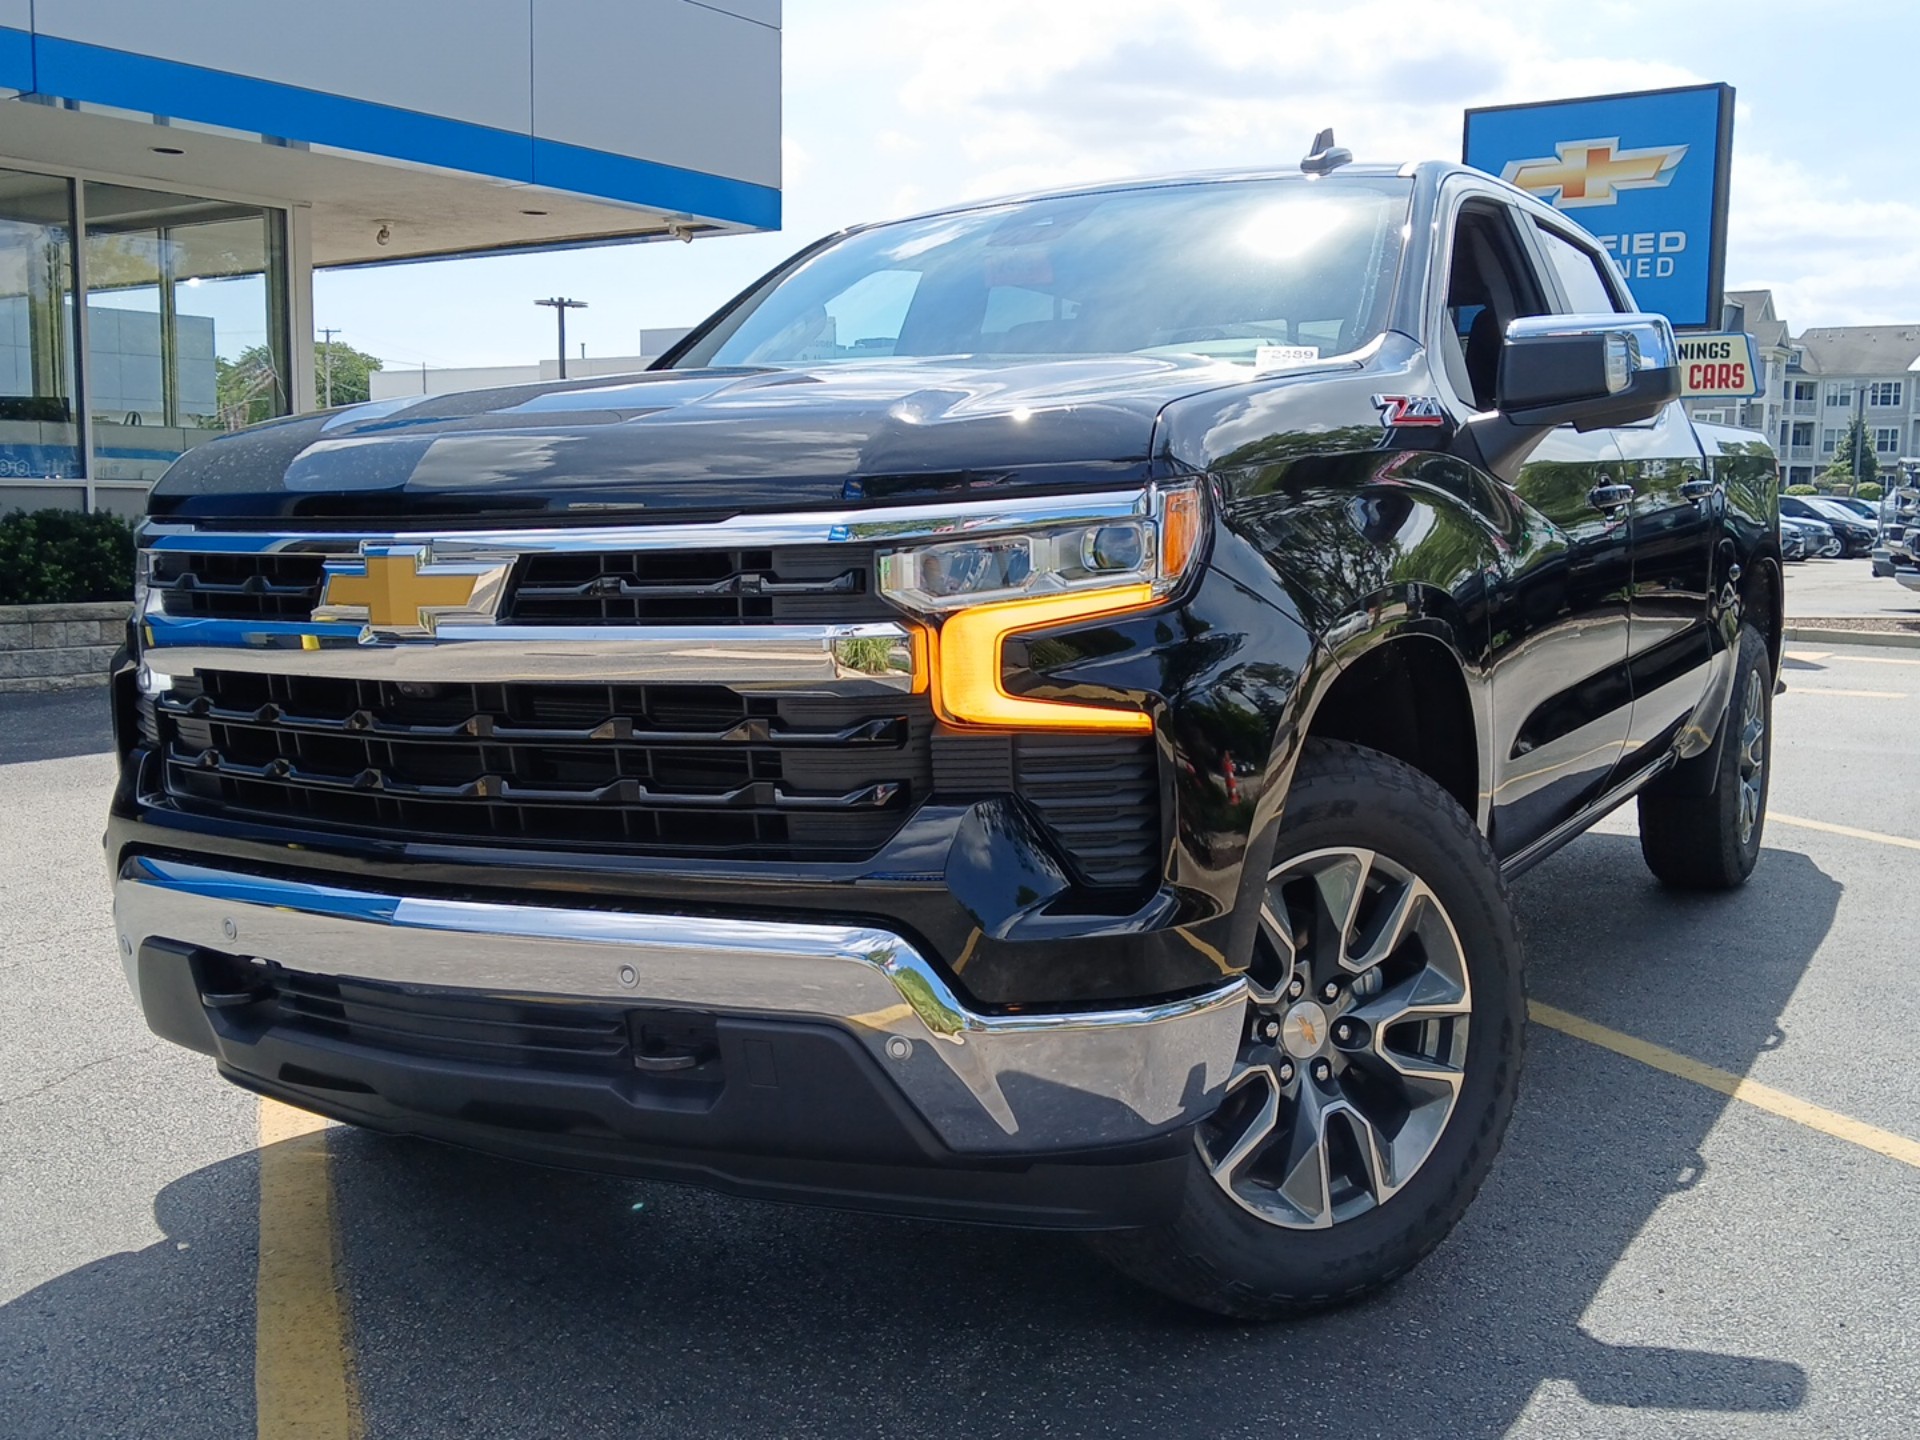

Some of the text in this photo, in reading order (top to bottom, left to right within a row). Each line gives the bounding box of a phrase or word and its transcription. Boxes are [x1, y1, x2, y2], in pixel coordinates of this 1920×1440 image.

[1598, 231, 1686, 255] FIED
[1678, 341, 1731, 360] NINGS
[1689, 362, 1745, 390] CARS
[1371, 392, 1444, 428] Z71
